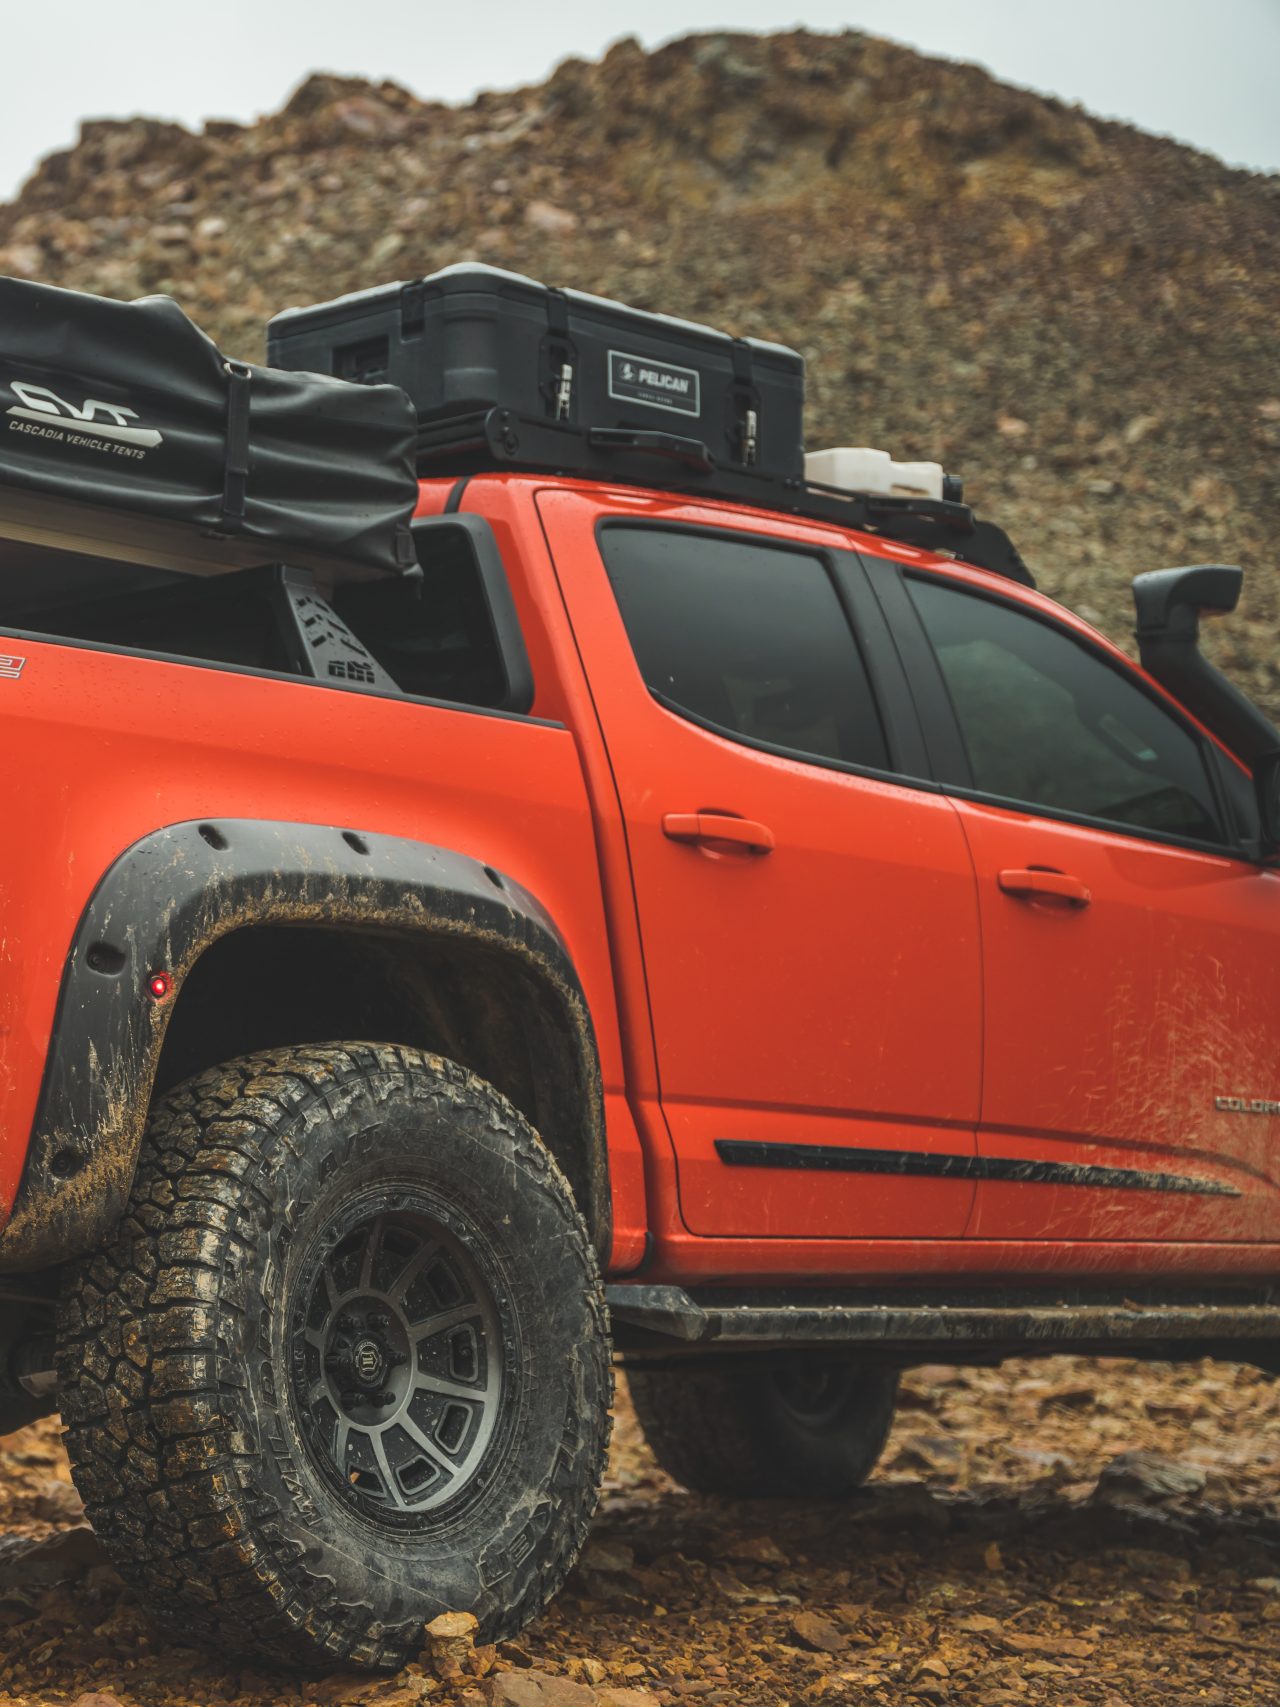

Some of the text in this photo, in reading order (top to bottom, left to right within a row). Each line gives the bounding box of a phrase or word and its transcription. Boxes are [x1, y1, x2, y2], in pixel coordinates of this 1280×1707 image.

[638, 368, 689, 393] PELICAN
[8, 420, 146, 460] CASCADIA VEHICLE TENTS
